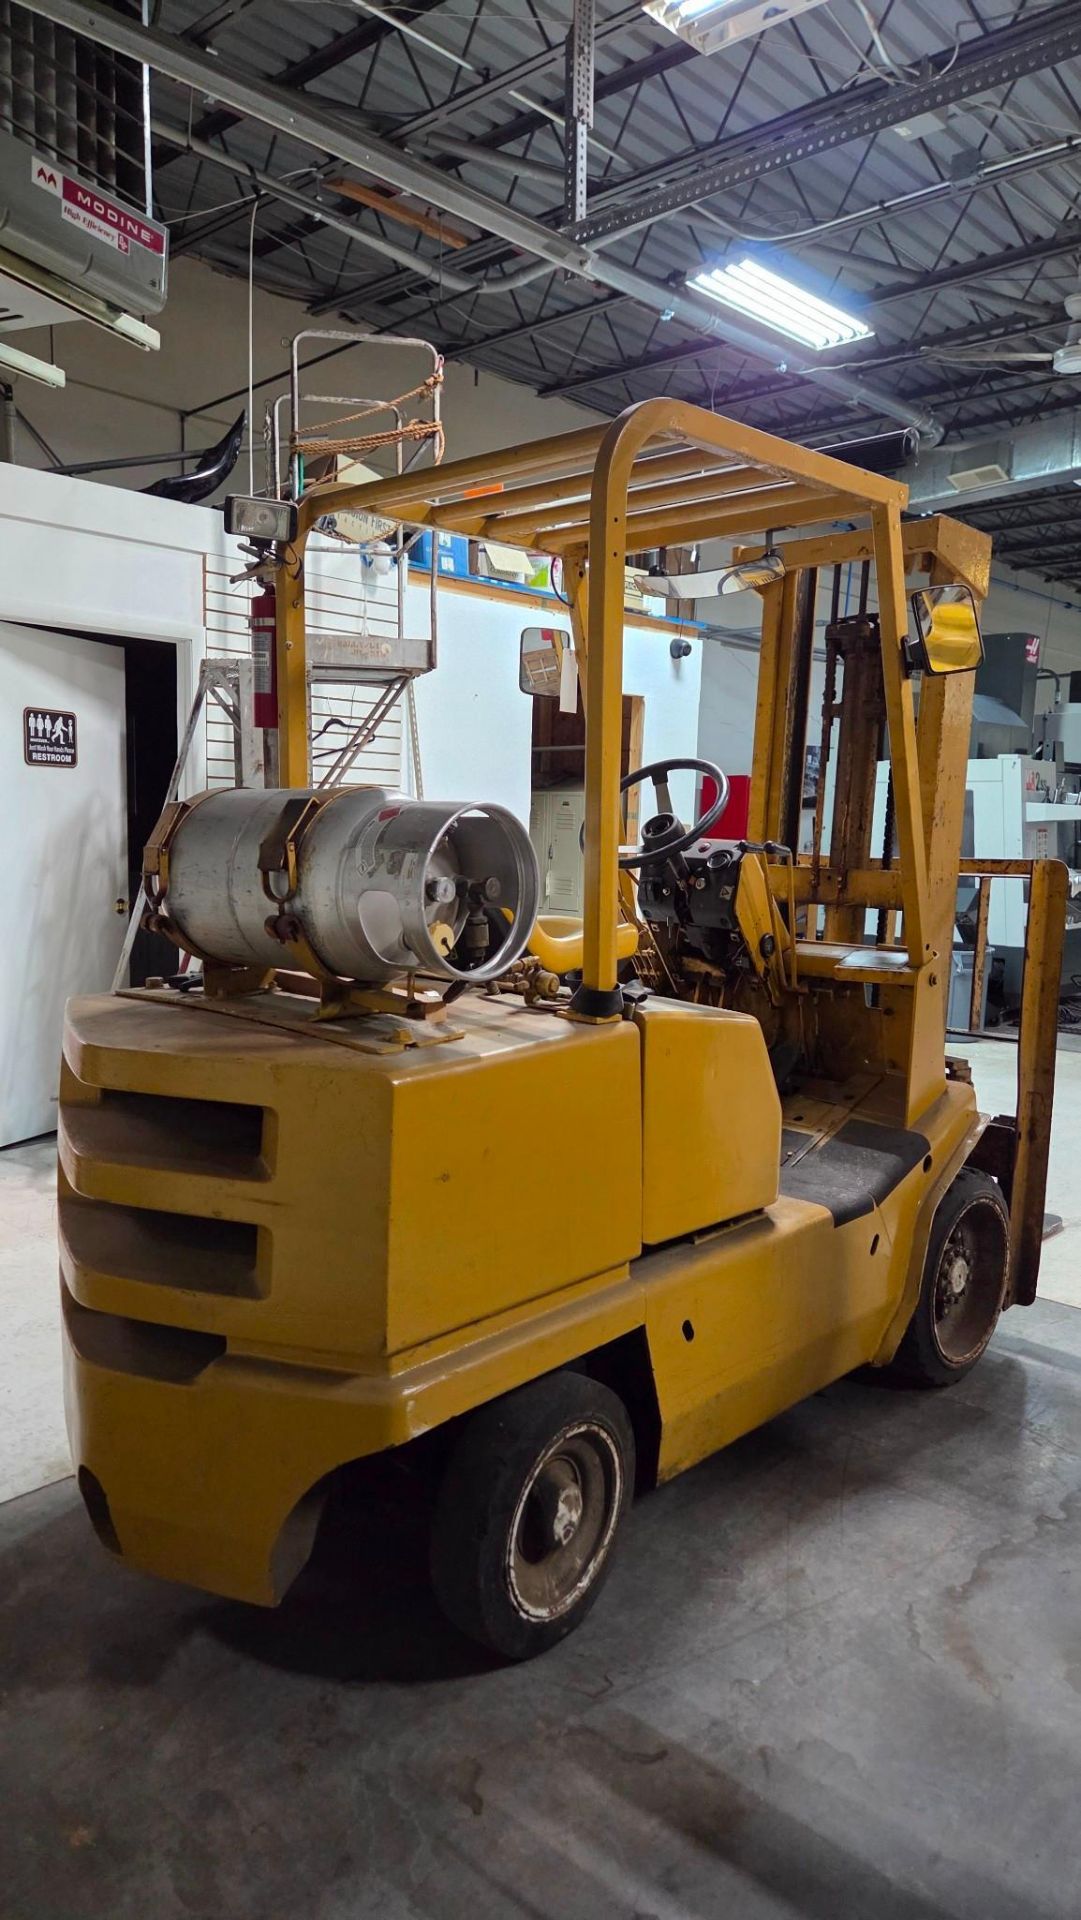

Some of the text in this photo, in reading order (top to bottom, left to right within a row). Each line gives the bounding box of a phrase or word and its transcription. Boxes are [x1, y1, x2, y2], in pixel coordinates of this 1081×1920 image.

[64, 205, 116, 241] High Efficiency
[77, 191, 151, 243] MODINE
[32, 752, 72, 763] RESTROOM
